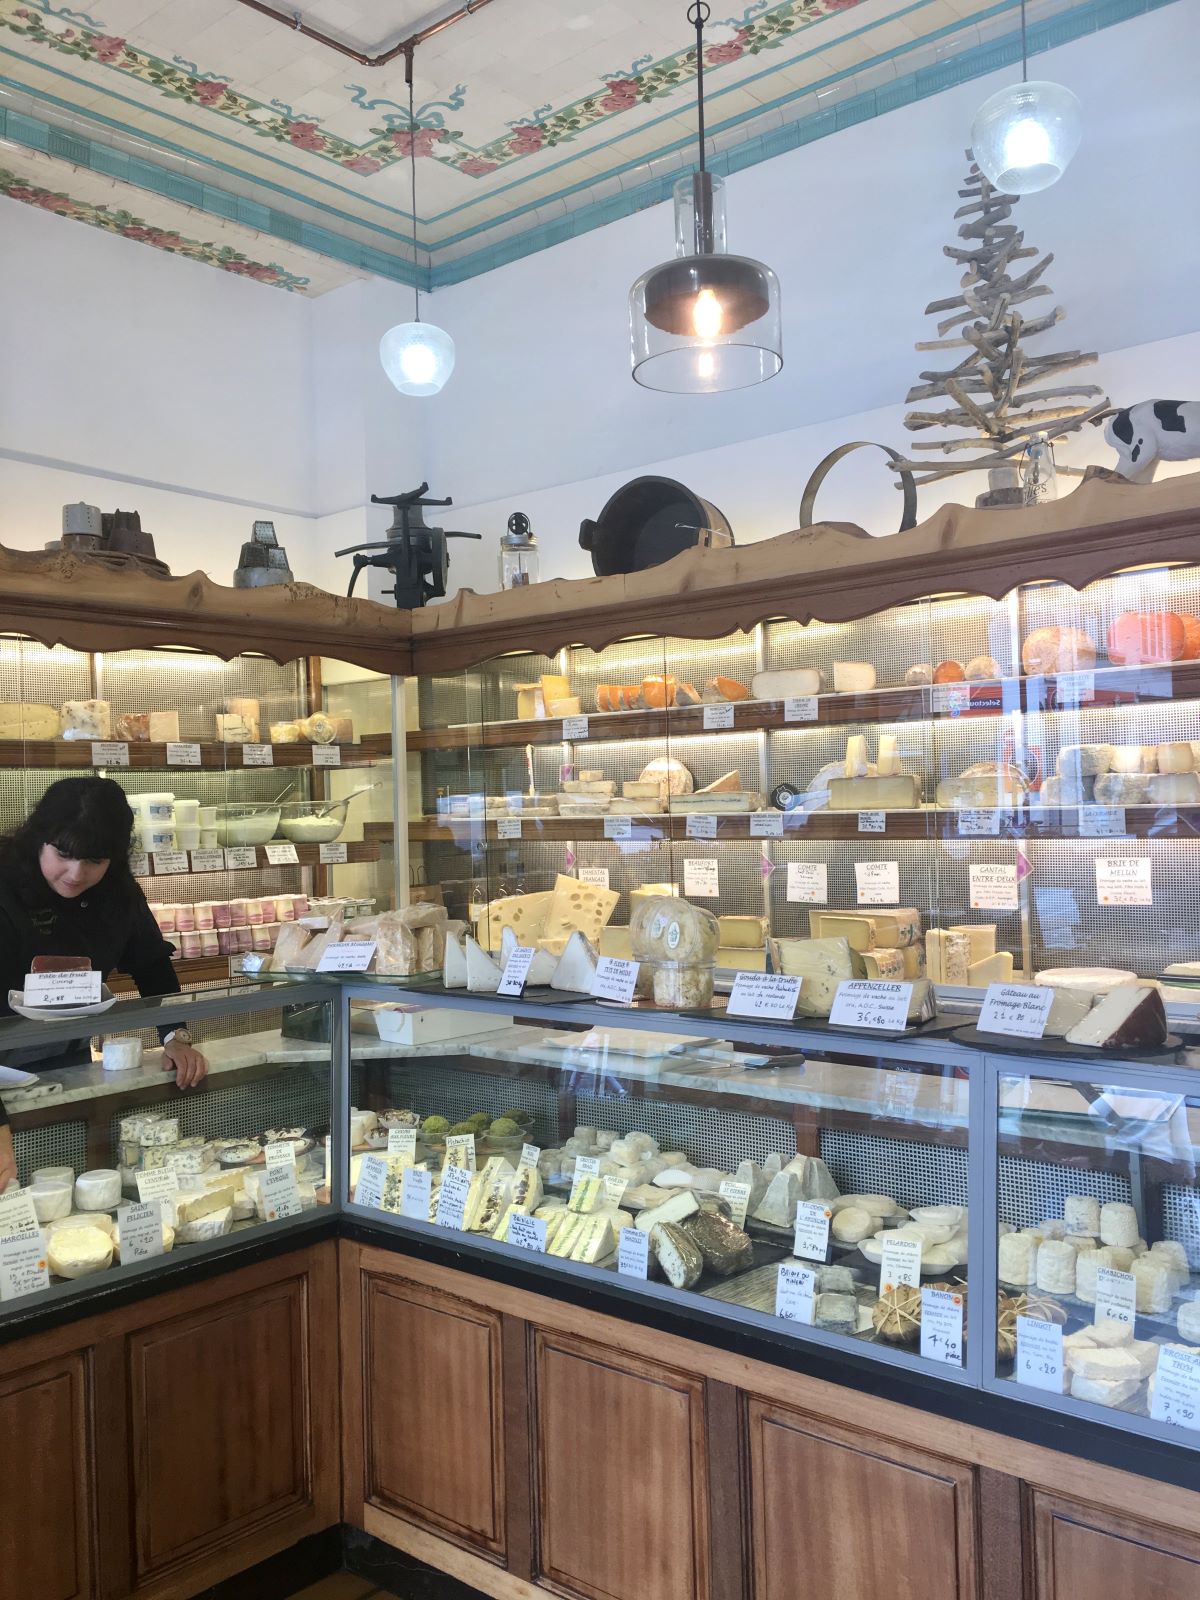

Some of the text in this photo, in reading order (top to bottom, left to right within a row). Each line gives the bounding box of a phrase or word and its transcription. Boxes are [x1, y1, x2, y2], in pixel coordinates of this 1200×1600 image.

[1107, 859, 1140, 867] BRIE DE
[980, 866, 1007, 874] CANTAL
[1110, 869, 1138, 877] MELUN
[847, 982, 902, 992] APPENZELLER
[1000, 988, 1028, 998] Gâteau
[989, 998, 1046, 1011] Fromage Blanc
[0, 1189, 27, 1201] AOURCE
[130, 1203, 149, 1214] SAINT
[0, 1230, 40, 1245] MAROILLES
[886, 1239, 918, 1249] PELARDON
[930, 1290, 954, 1301] BANON
[1026, 1319, 1053, 1332] LINGOT
